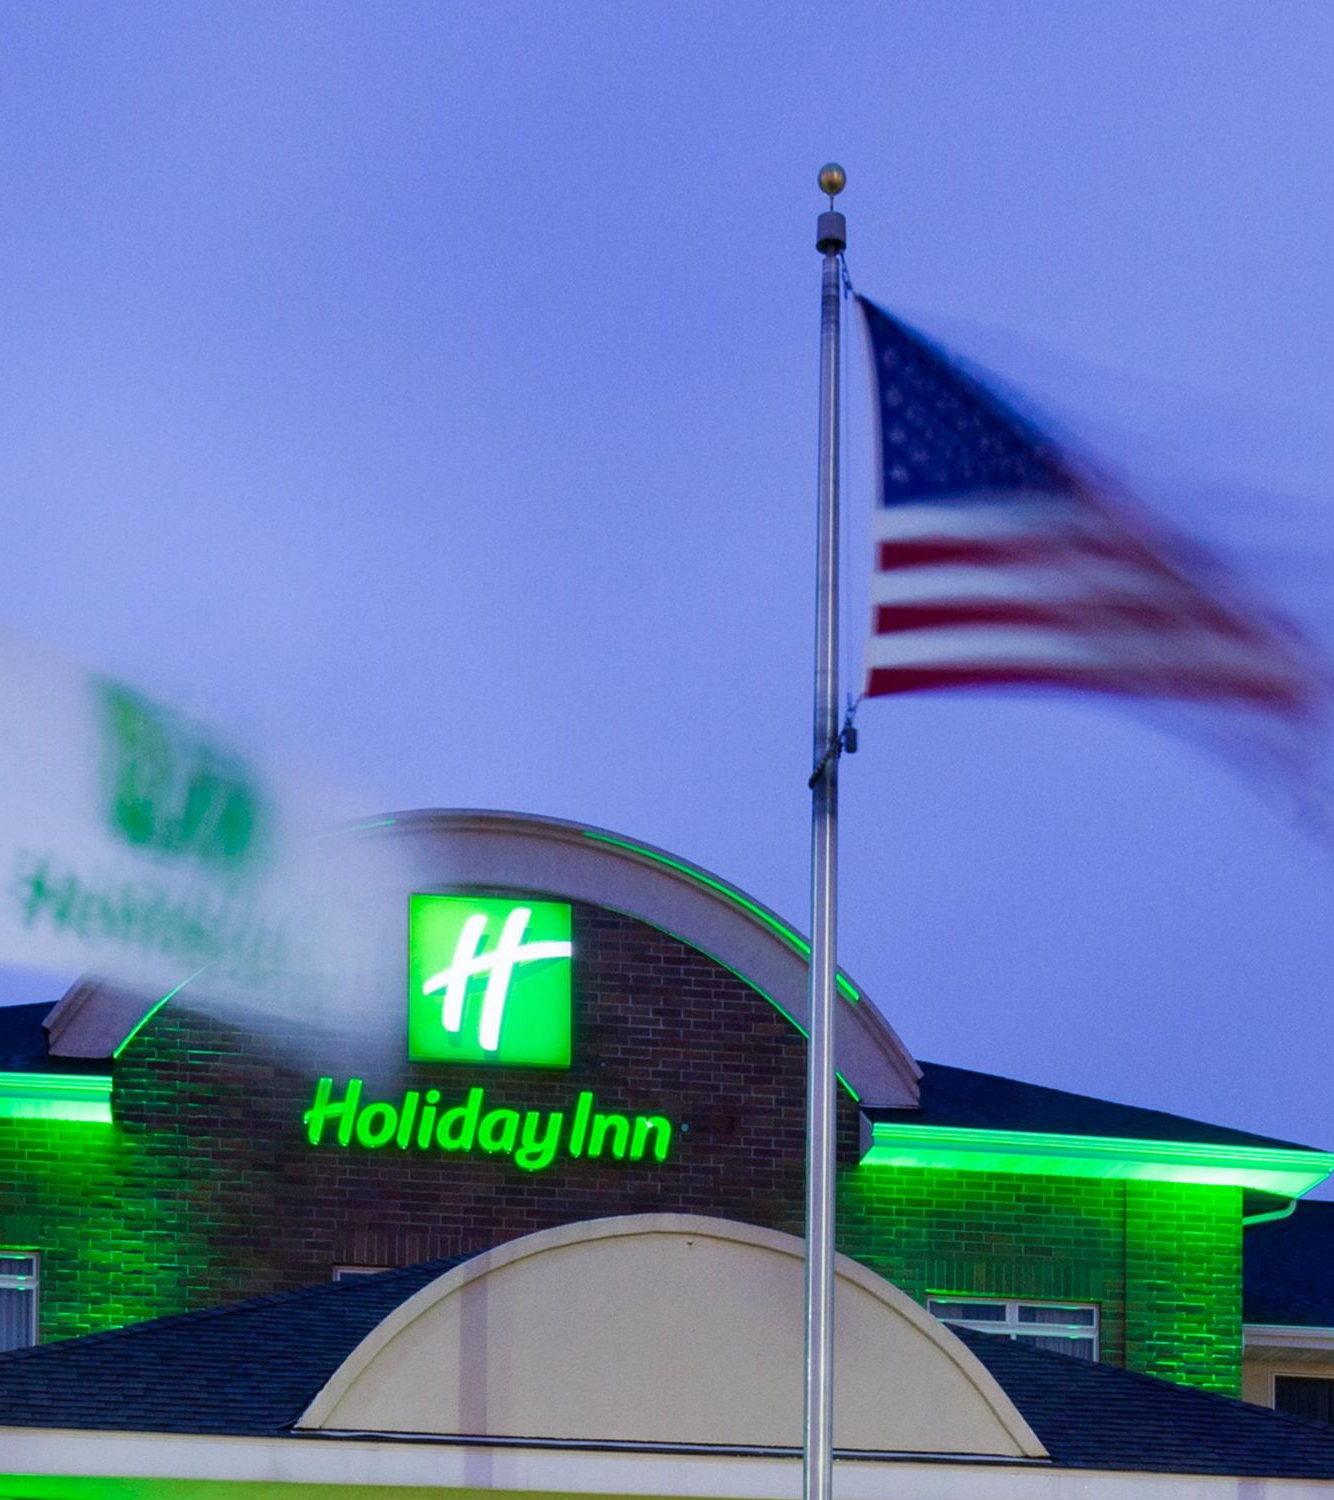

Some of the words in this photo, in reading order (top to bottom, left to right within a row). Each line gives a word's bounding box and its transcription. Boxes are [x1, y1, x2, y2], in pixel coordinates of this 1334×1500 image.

[423, 908, 571, 1051] H
[302, 1076, 564, 1172] Holiday
[567, 1091, 672, 1163] Inn
